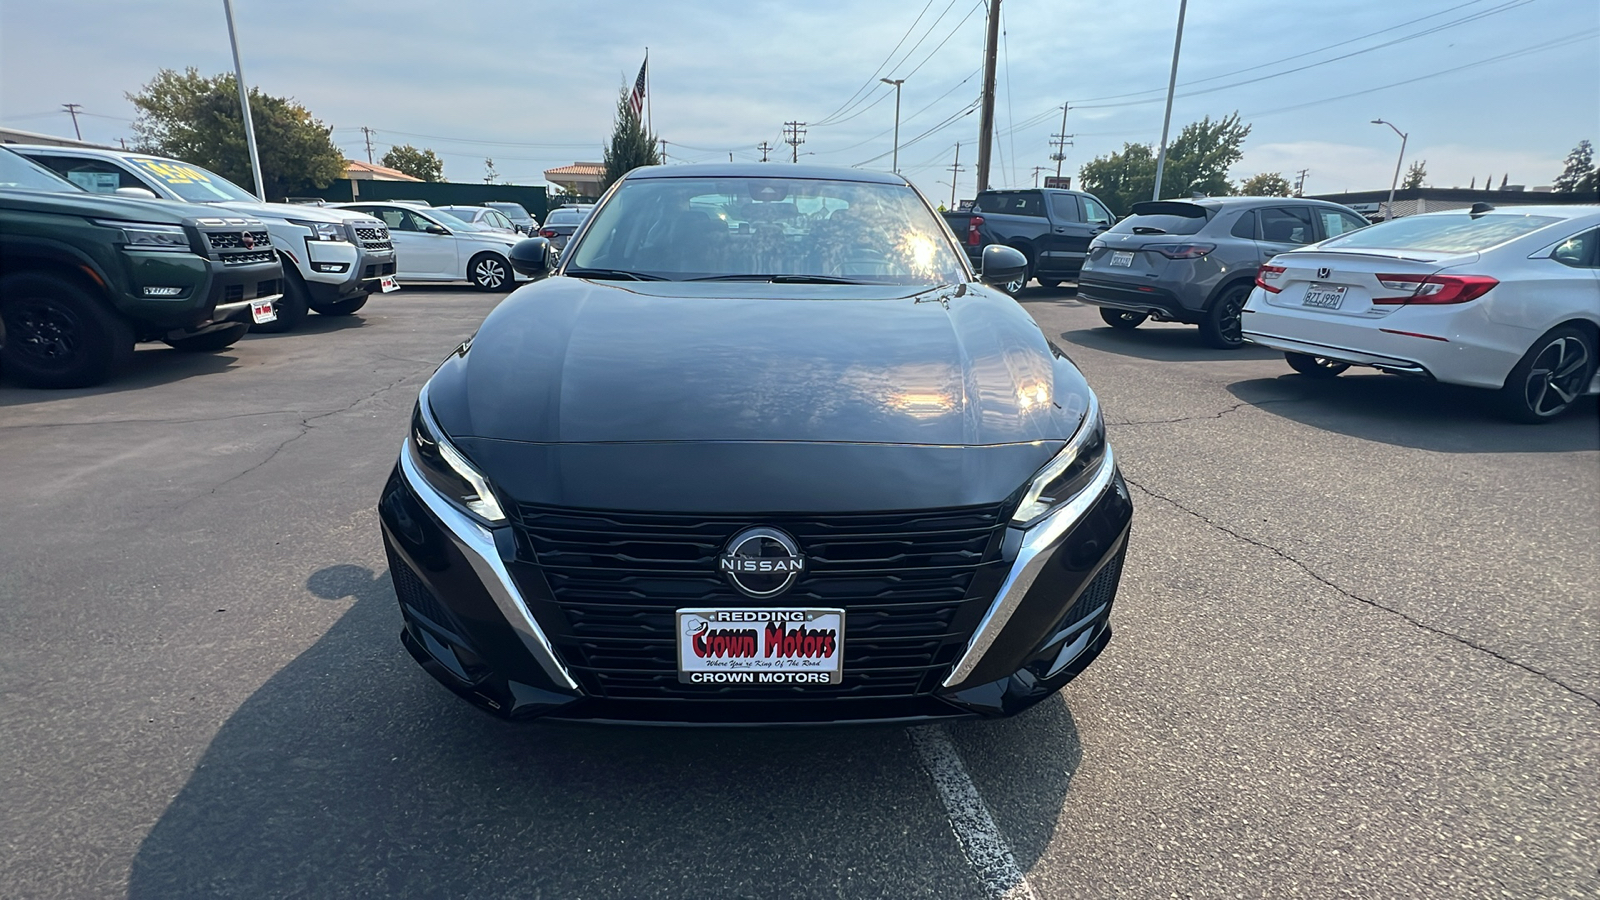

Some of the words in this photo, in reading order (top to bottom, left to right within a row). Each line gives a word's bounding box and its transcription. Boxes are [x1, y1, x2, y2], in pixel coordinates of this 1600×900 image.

[721, 558, 803, 572] NISSAN
[717, 611, 804, 621] REDDING
[692, 621, 758, 658] Crown
[764, 621, 837, 658] Motors
[706, 659, 728, 667] Where
[729, 659, 753, 669] You're
[754, 659, 772, 668] King
[774, 659, 784, 668] Of
[786, 659, 800, 667] The
[802, 659, 821, 667] Road
[690, 672, 754, 683] CROWN
[758, 672, 830, 683] MOTORS
